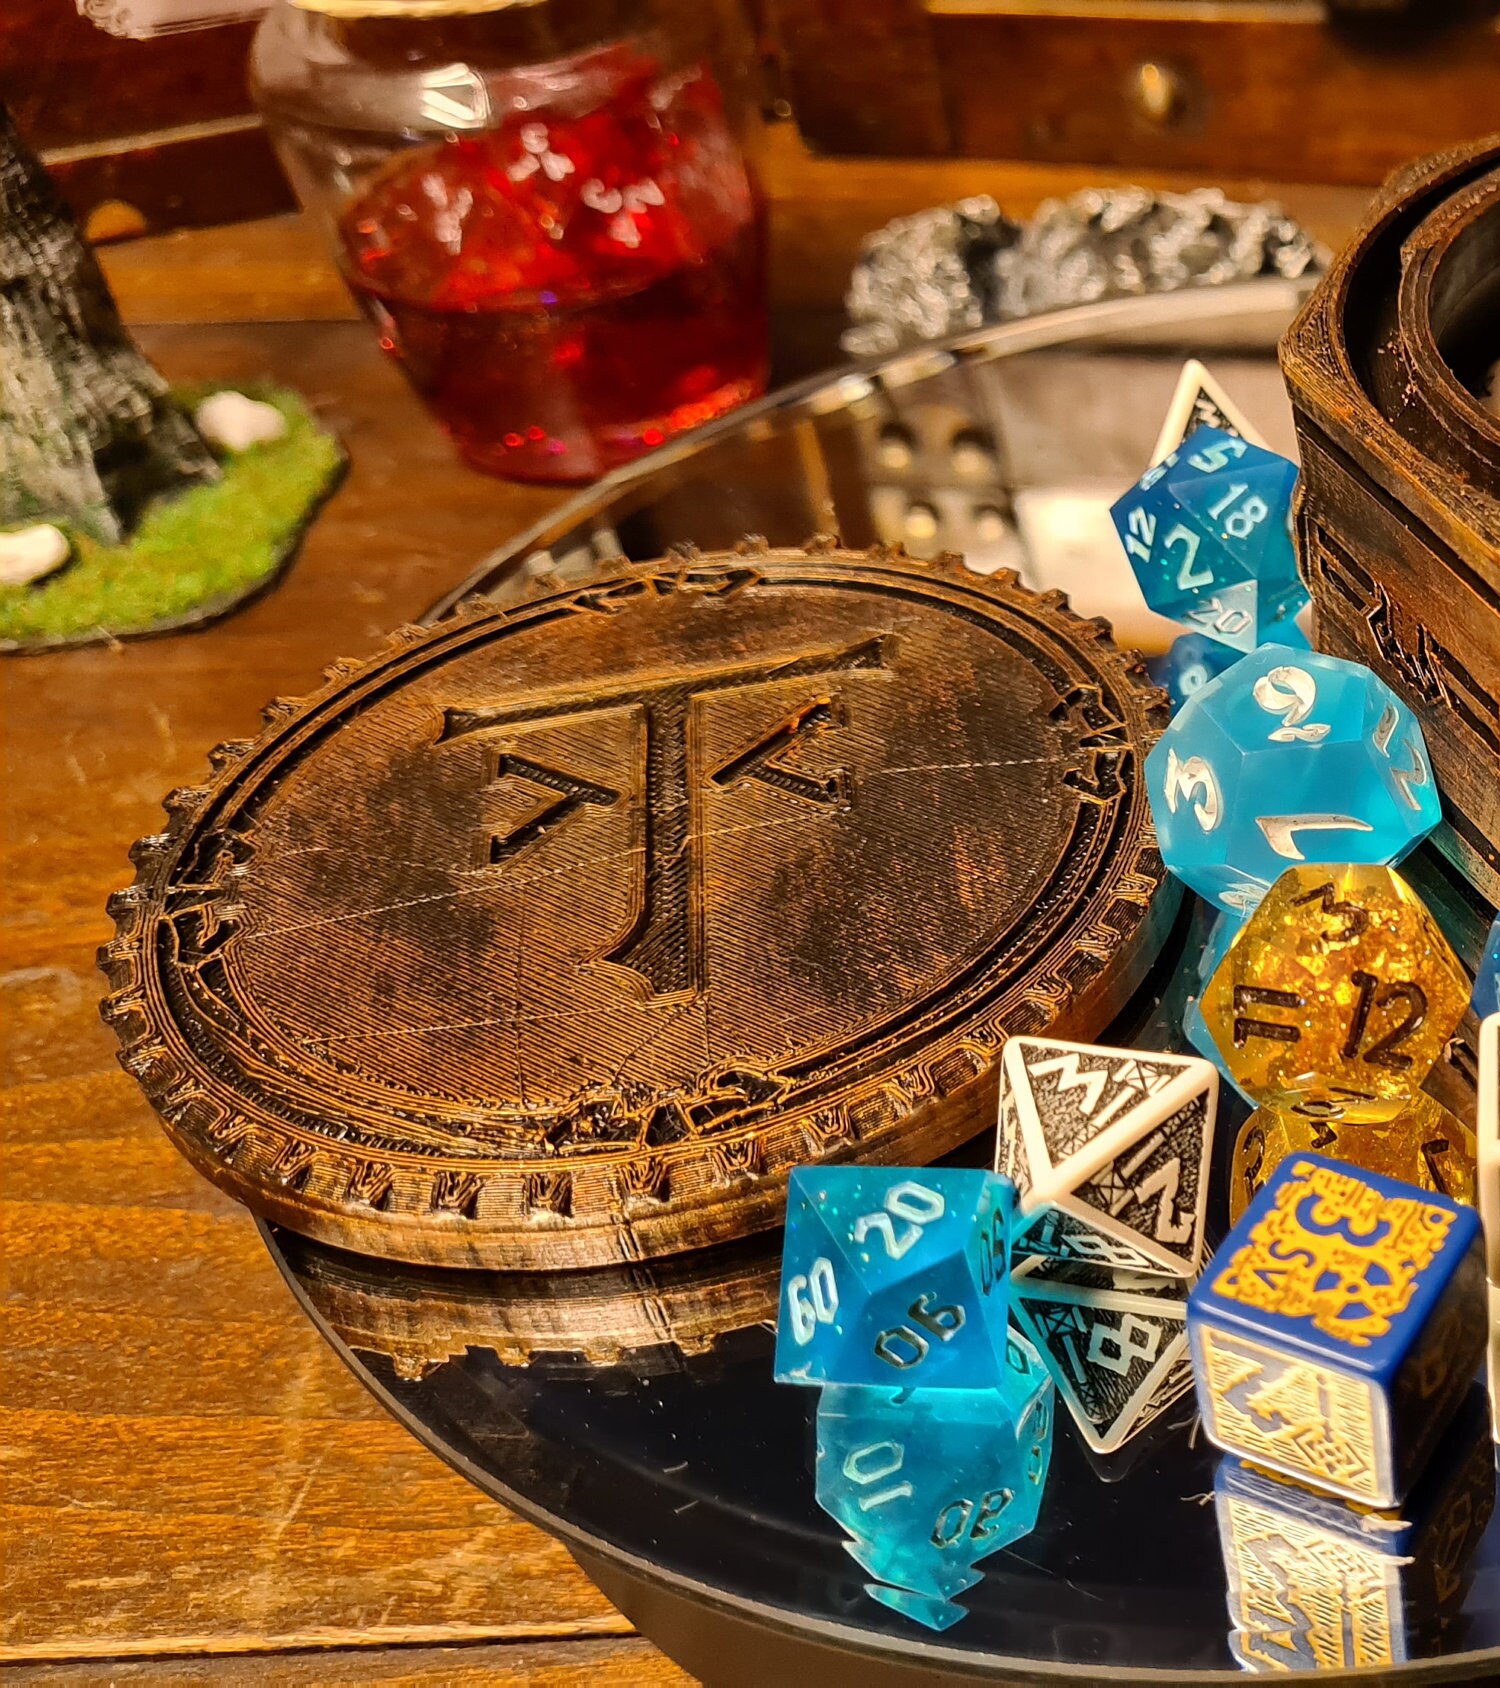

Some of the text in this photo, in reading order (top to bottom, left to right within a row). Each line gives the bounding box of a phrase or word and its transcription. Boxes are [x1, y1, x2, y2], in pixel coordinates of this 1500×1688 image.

[1125, 506, 1157, 563] 12
[1207, 483, 1269, 539] 18
[1164, 523, 1214, 590] 2
[1182, 597, 1252, 635] 20
[1164, 747, 1224, 832] 3
[1233, 984, 1303, 1049] 11
[1342, 970, 1429, 1070] 12
[854, 1181, 945, 1260] 20
[787, 1257, 835, 1345] 60
